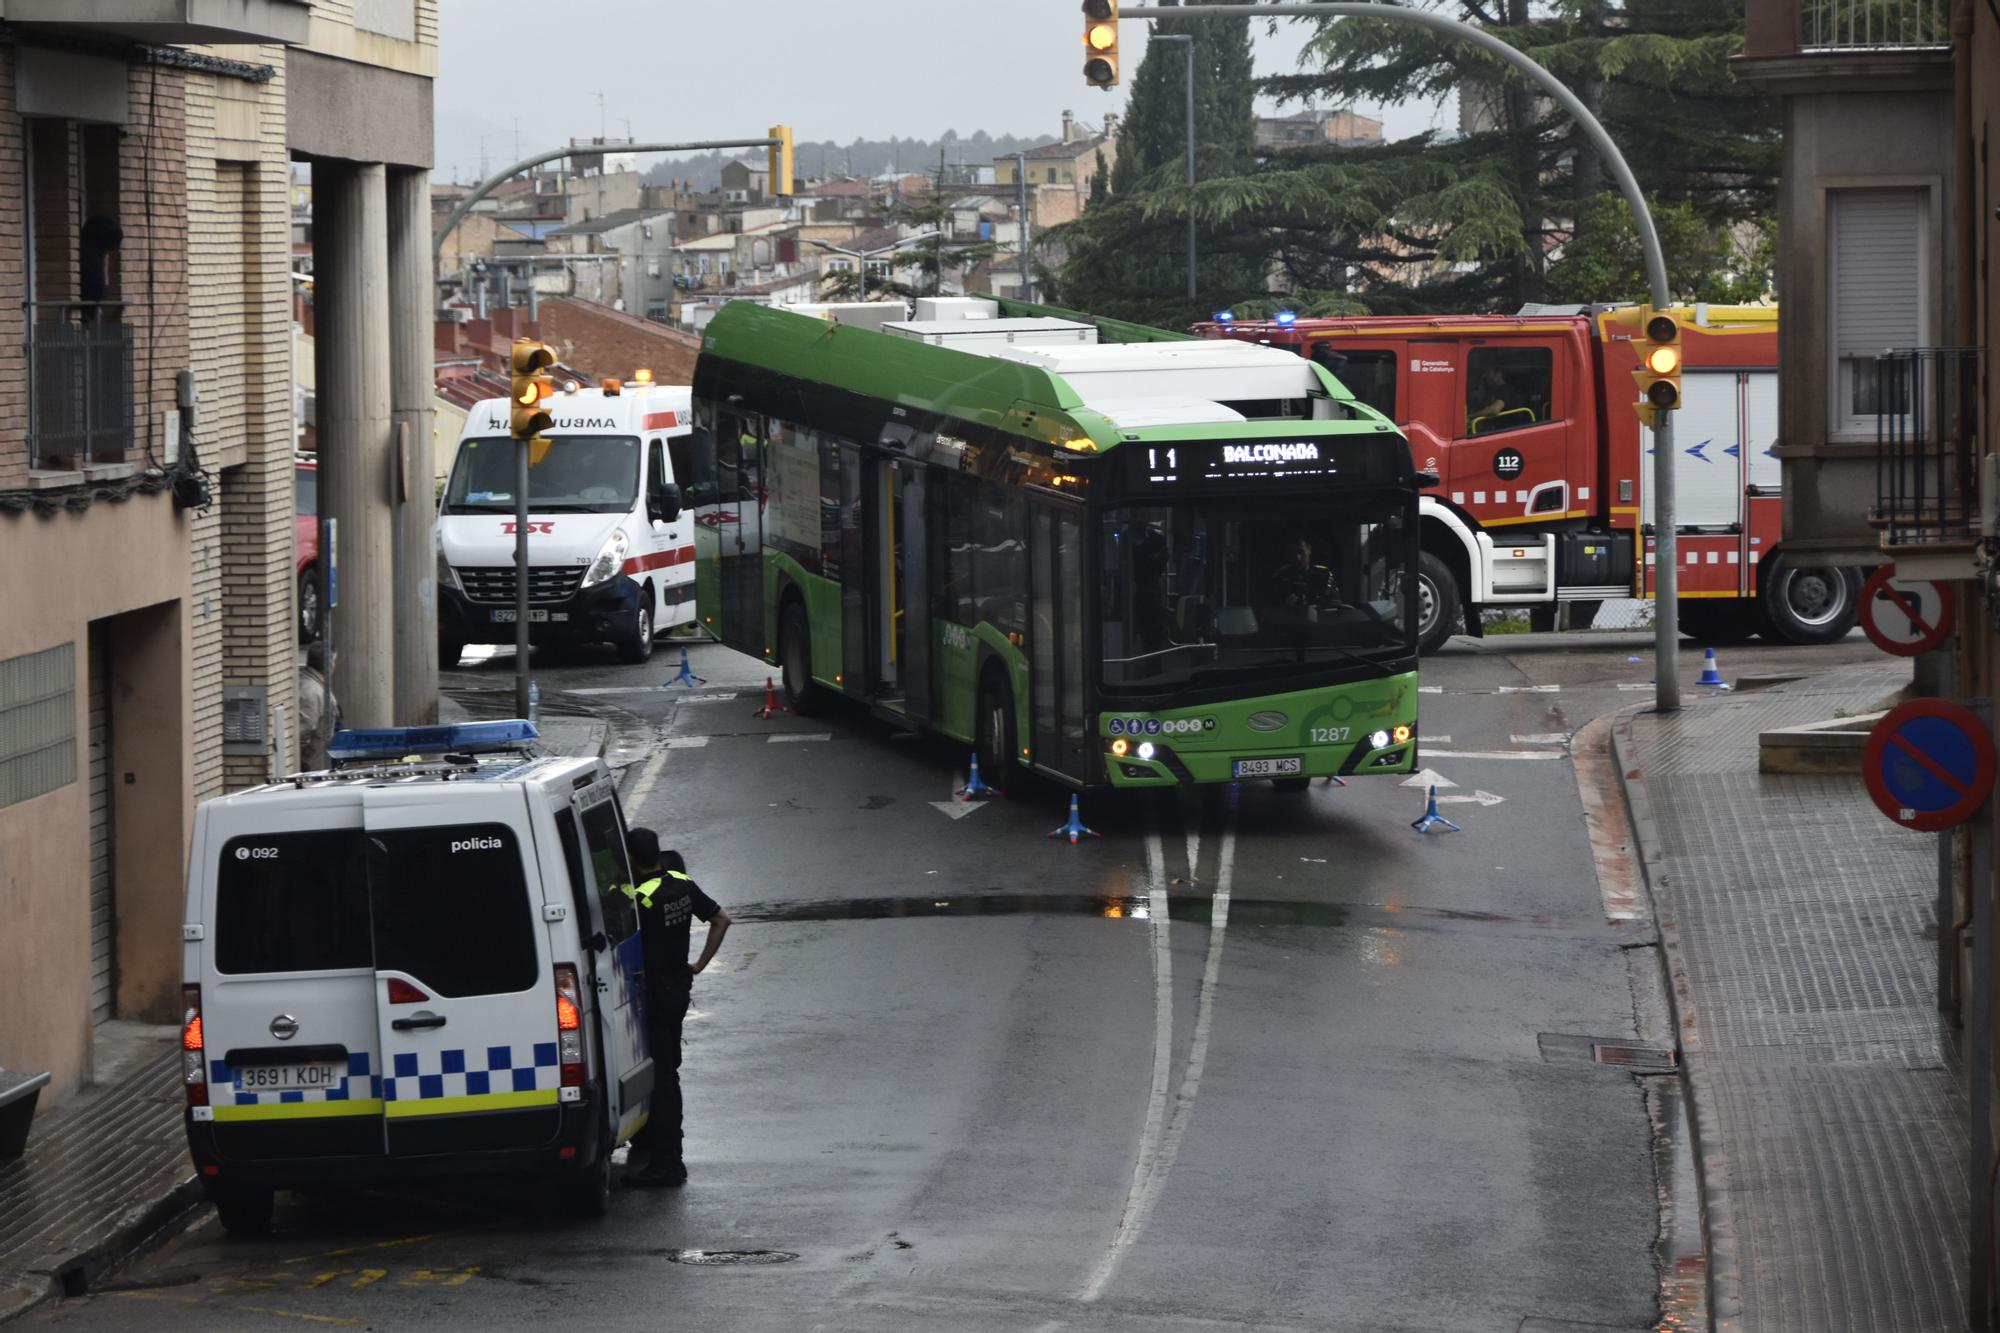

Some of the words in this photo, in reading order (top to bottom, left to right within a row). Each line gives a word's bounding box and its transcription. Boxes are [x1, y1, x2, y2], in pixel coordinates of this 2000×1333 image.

[1223, 443, 1319, 463] BALCONADA
[1498, 456, 1520, 468] 112
[1310, 727, 1350, 742] 1287
[1241, 761, 1269, 773] 8493
[1276, 760, 1297, 772] MCS
[451, 837, 502, 853] policia
[252, 847, 279, 859] 092
[246, 1069, 289, 1086] 3691
[296, 1067, 332, 1085] KDH
